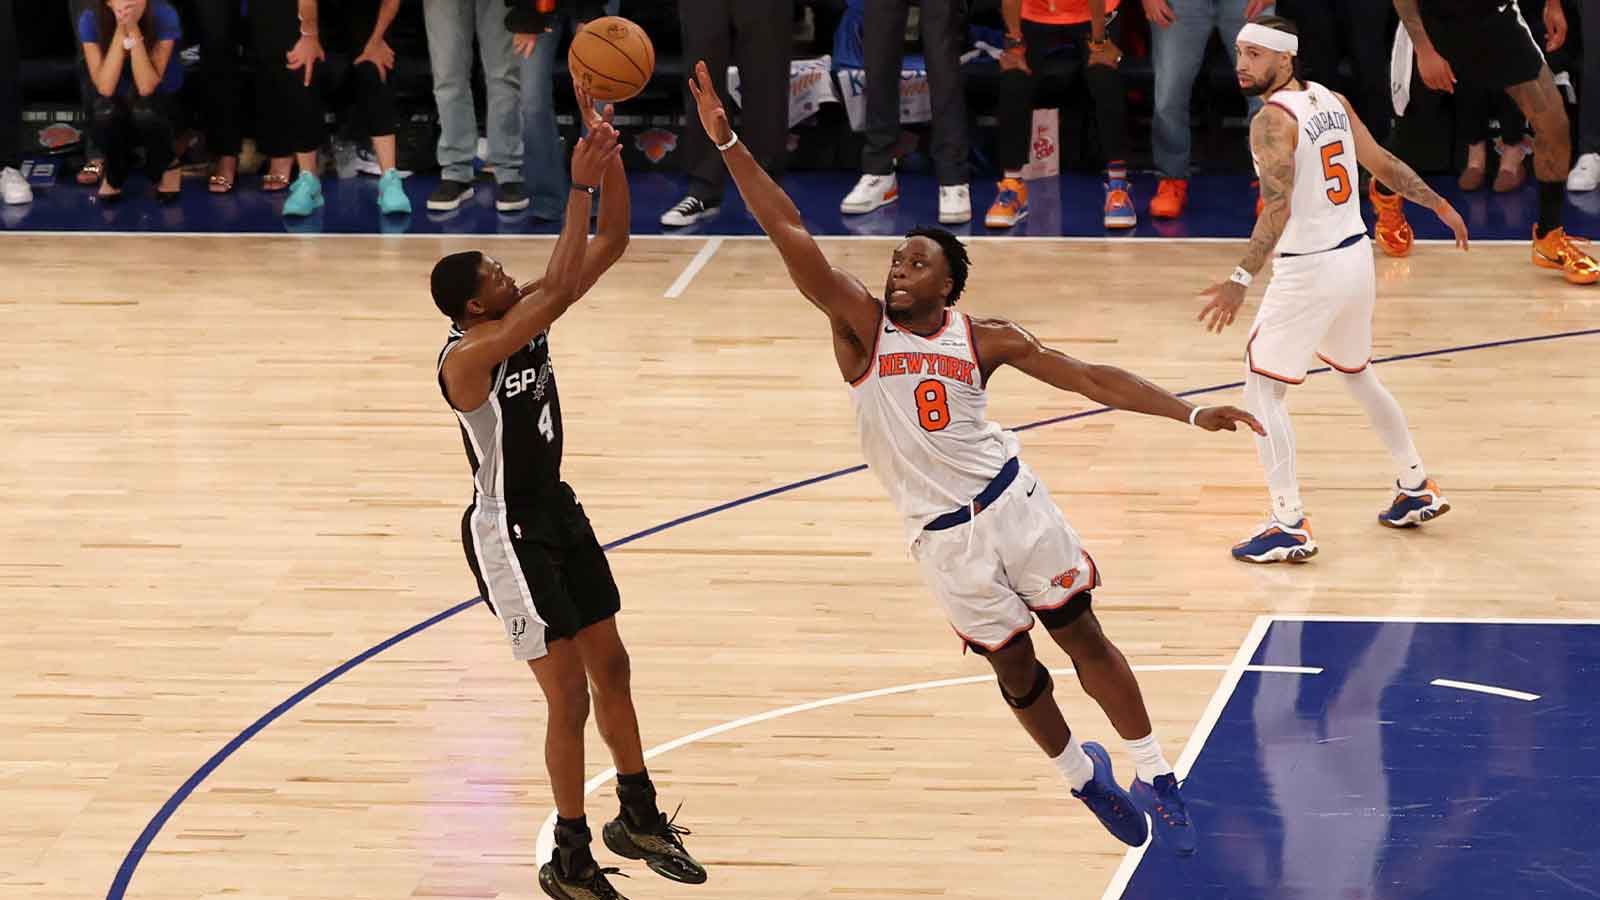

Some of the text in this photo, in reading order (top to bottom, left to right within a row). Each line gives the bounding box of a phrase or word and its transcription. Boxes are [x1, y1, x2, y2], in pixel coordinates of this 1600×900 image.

[1305, 111, 1347, 144] ALVARADO
[1320, 140, 1352, 205] 5
[538, 401, 554, 442] 4
[914, 378, 951, 432] 8
